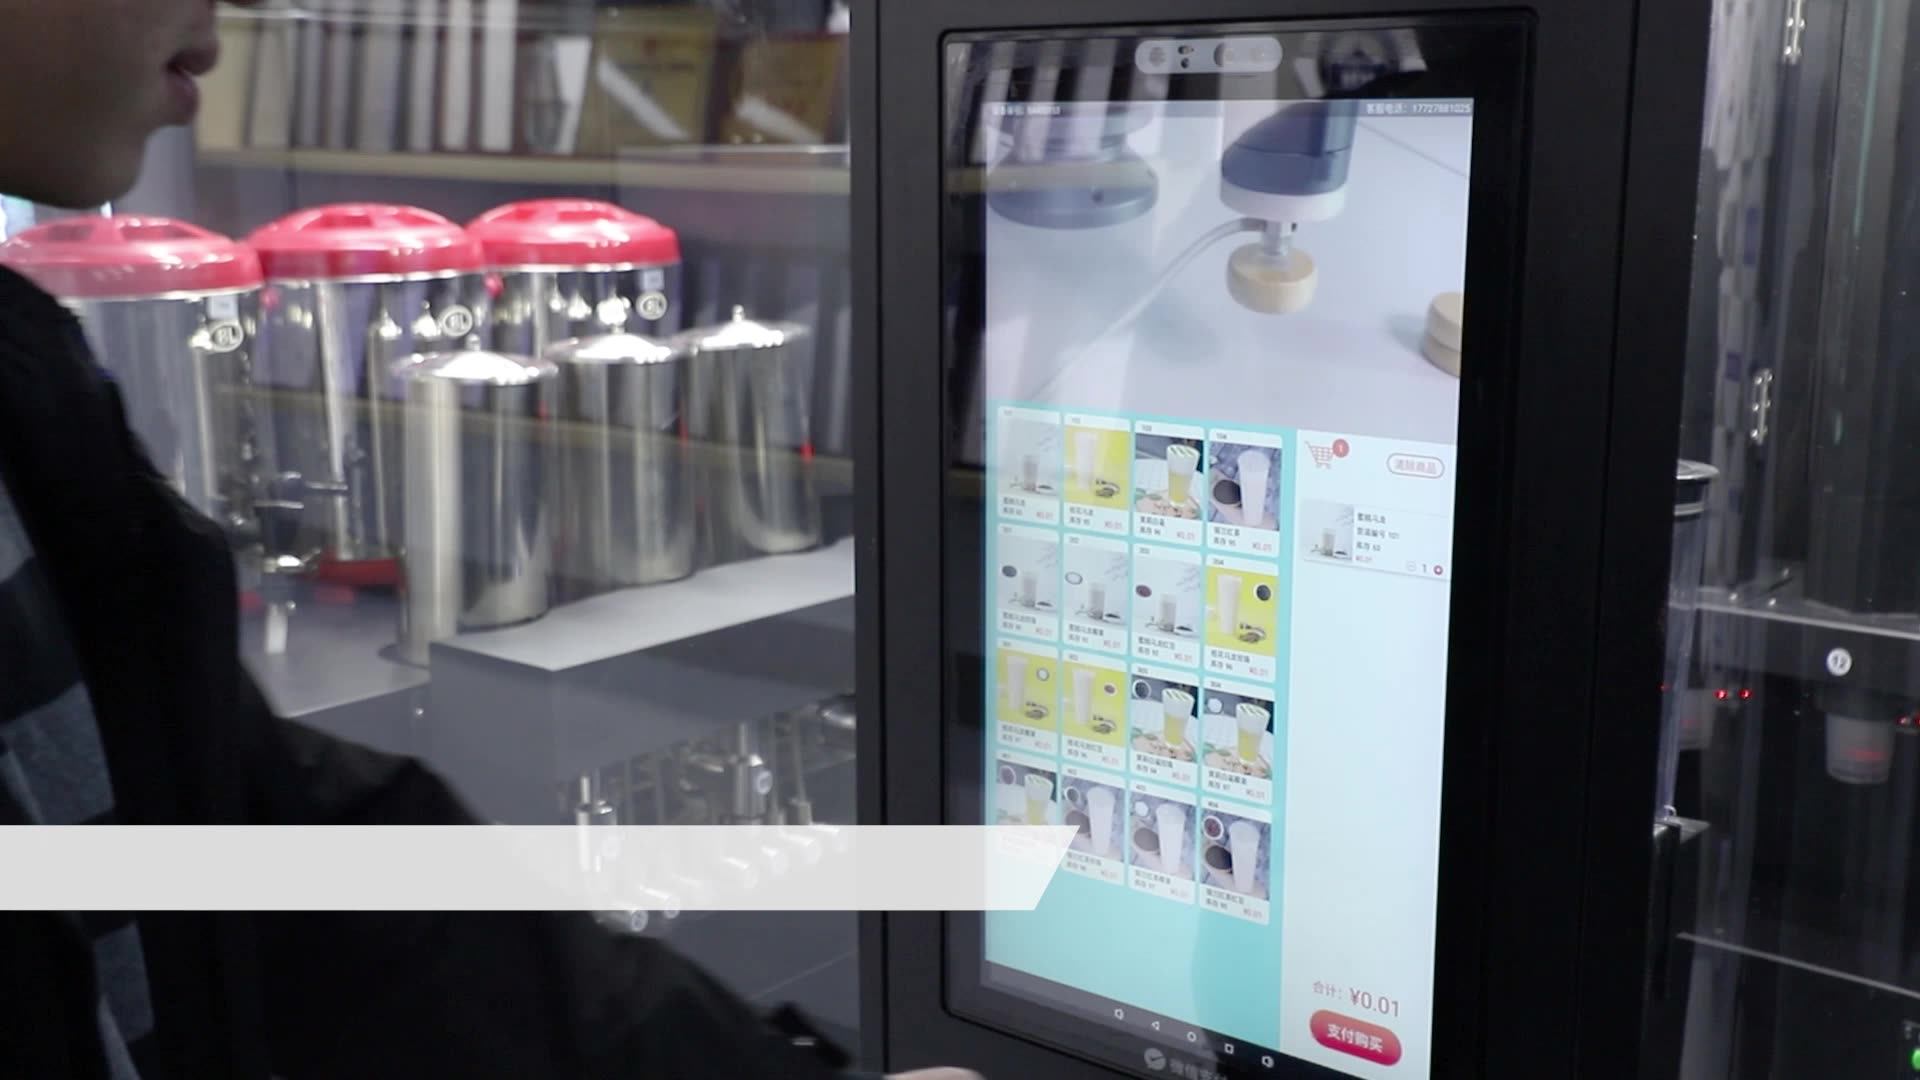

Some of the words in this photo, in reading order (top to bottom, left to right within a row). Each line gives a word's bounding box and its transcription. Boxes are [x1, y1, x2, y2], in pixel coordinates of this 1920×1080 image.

[1350, 988, 1401, 1018] ¥0.01
[1327, 1022, 1384, 1054] 支付购买
